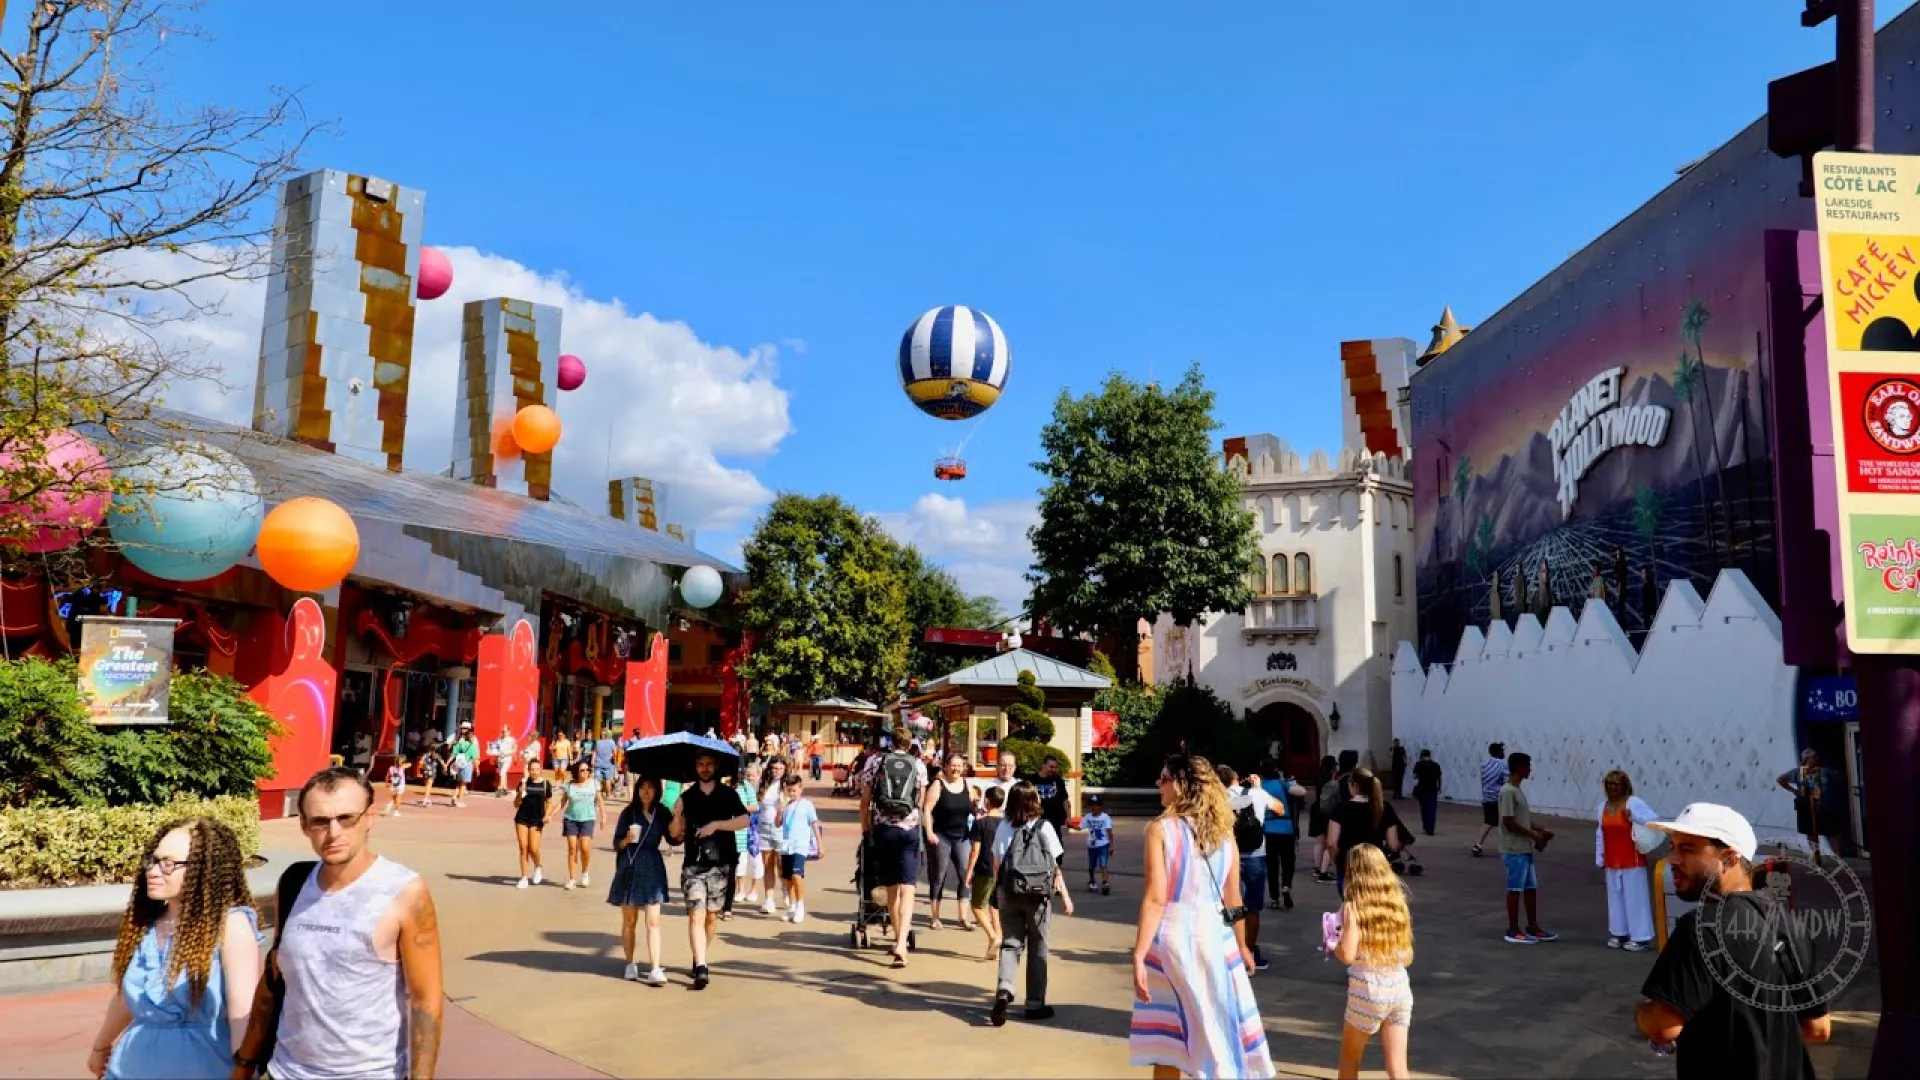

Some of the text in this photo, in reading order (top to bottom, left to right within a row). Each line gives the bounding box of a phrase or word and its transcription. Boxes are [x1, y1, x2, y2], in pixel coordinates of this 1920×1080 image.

[1823, 164, 1897, 176] RESTAURANTS
[1824, 175, 1864, 192] CÔTÉ
[1868, 179, 1897, 193] LAC
[1825, 198, 1873, 210] LAKESIDE
[1826, 209, 1900, 221] RESTAURANTS
[1837, 237, 1888, 297] CAFÉ
[1845, 245, 1917, 325] MICKEY
[1871, 384, 1906, 407] EARL
[1547, 365, 1627, 484] PLANET
[1556, 404, 1672, 522] HOLLYWOOD
[1859, 467, 1882, 476] HOT
[112, 645, 145, 660] The
[95, 659, 159, 673] Greatest
